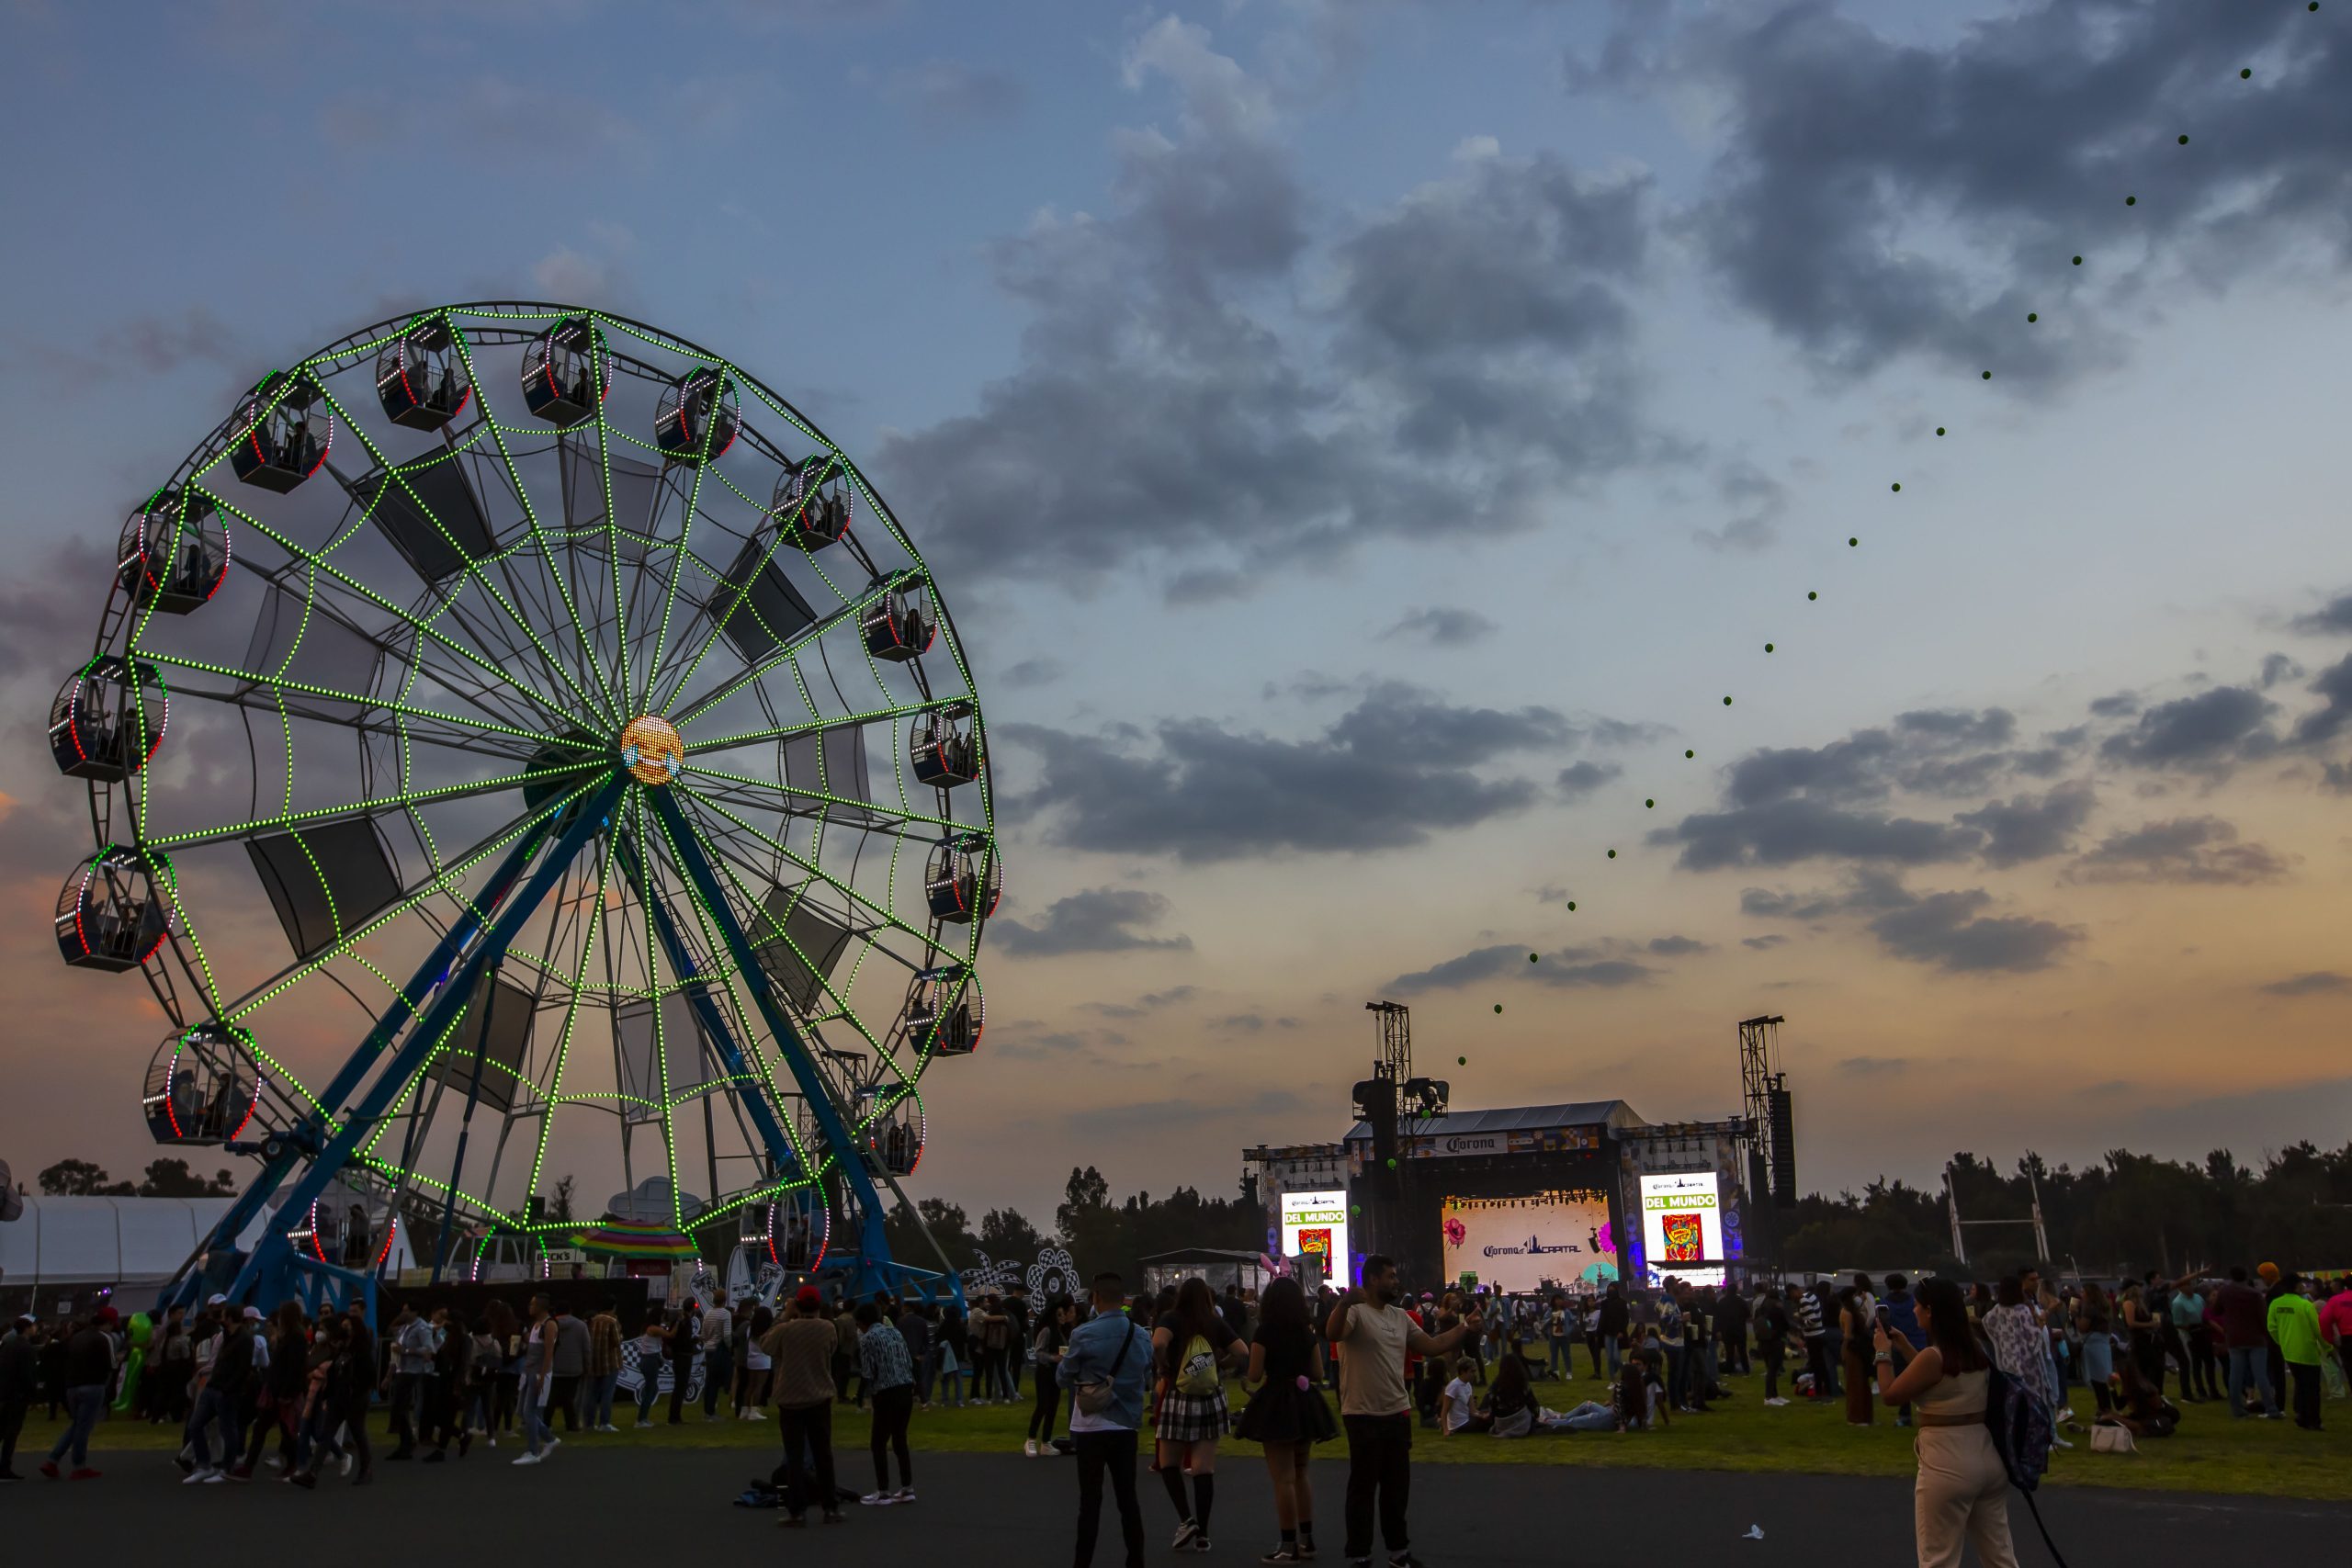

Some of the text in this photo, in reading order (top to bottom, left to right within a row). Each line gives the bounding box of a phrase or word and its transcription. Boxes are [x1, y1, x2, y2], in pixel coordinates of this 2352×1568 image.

[1446, 1137, 1495, 1154] Corona
[1646, 1196, 1715, 1208] DEL MUNDO
[1286, 1213, 1344, 1223] DEL MUNDO
[1483, 1245, 1581, 1258] Corona CAPITAL
